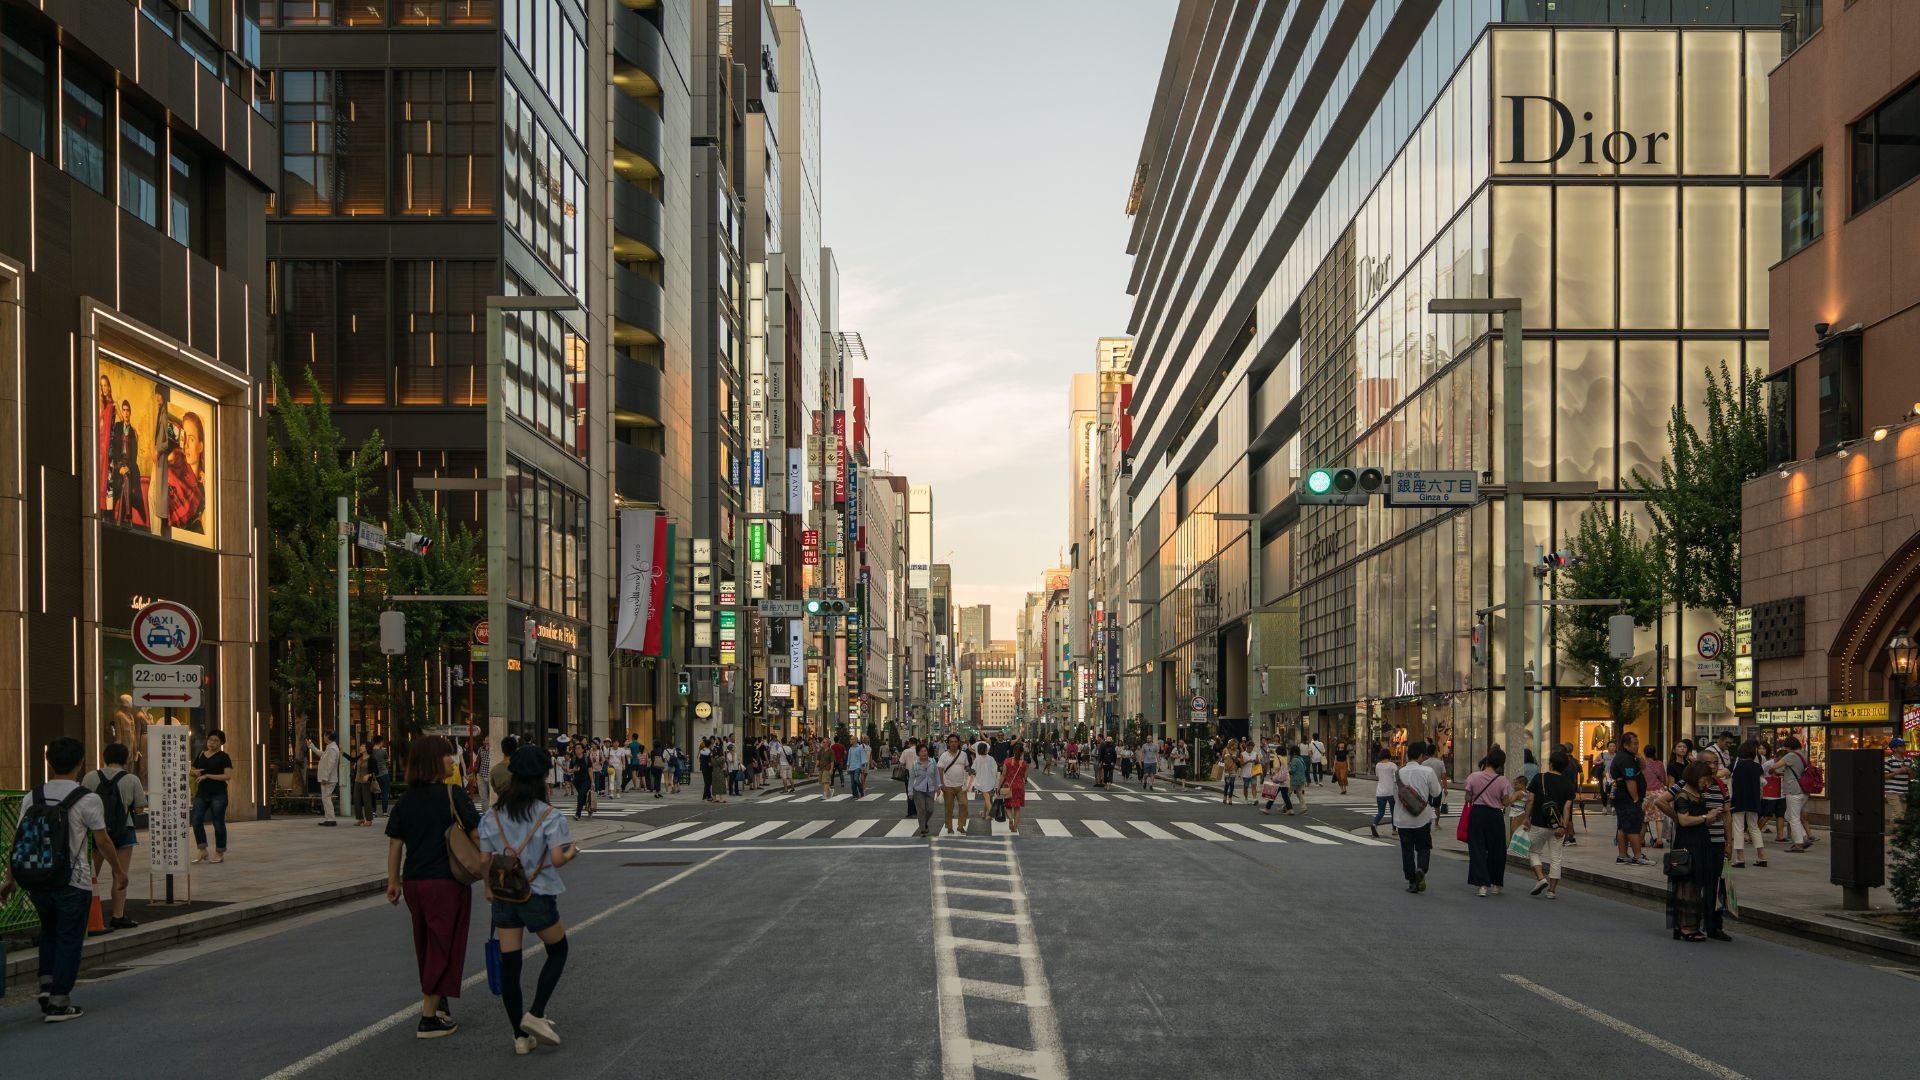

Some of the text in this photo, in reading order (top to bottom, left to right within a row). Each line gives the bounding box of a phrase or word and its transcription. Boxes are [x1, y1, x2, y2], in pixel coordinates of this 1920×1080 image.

[1500, 96, 1670, 165] Dior
[1357, 254, 1391, 315] Dior
[790, 469, 799, 498] DIANA
[836, 450, 844, 495] NATARAJ
[1397, 479, 1471, 493] 銀座六丁目
[148, 616, 173, 624] TAXI
[753, 619, 761, 643] マギー
[792, 641, 800, 669] DIANA
[136, 670, 198, 682] 22:00-1:00
[1396, 668, 1415, 696] Dior
[753, 681, 762, 714] タカゲン
[1833, 708, 1856, 717] ビヤホール
[1872, 707, 1887, 716] HALL
